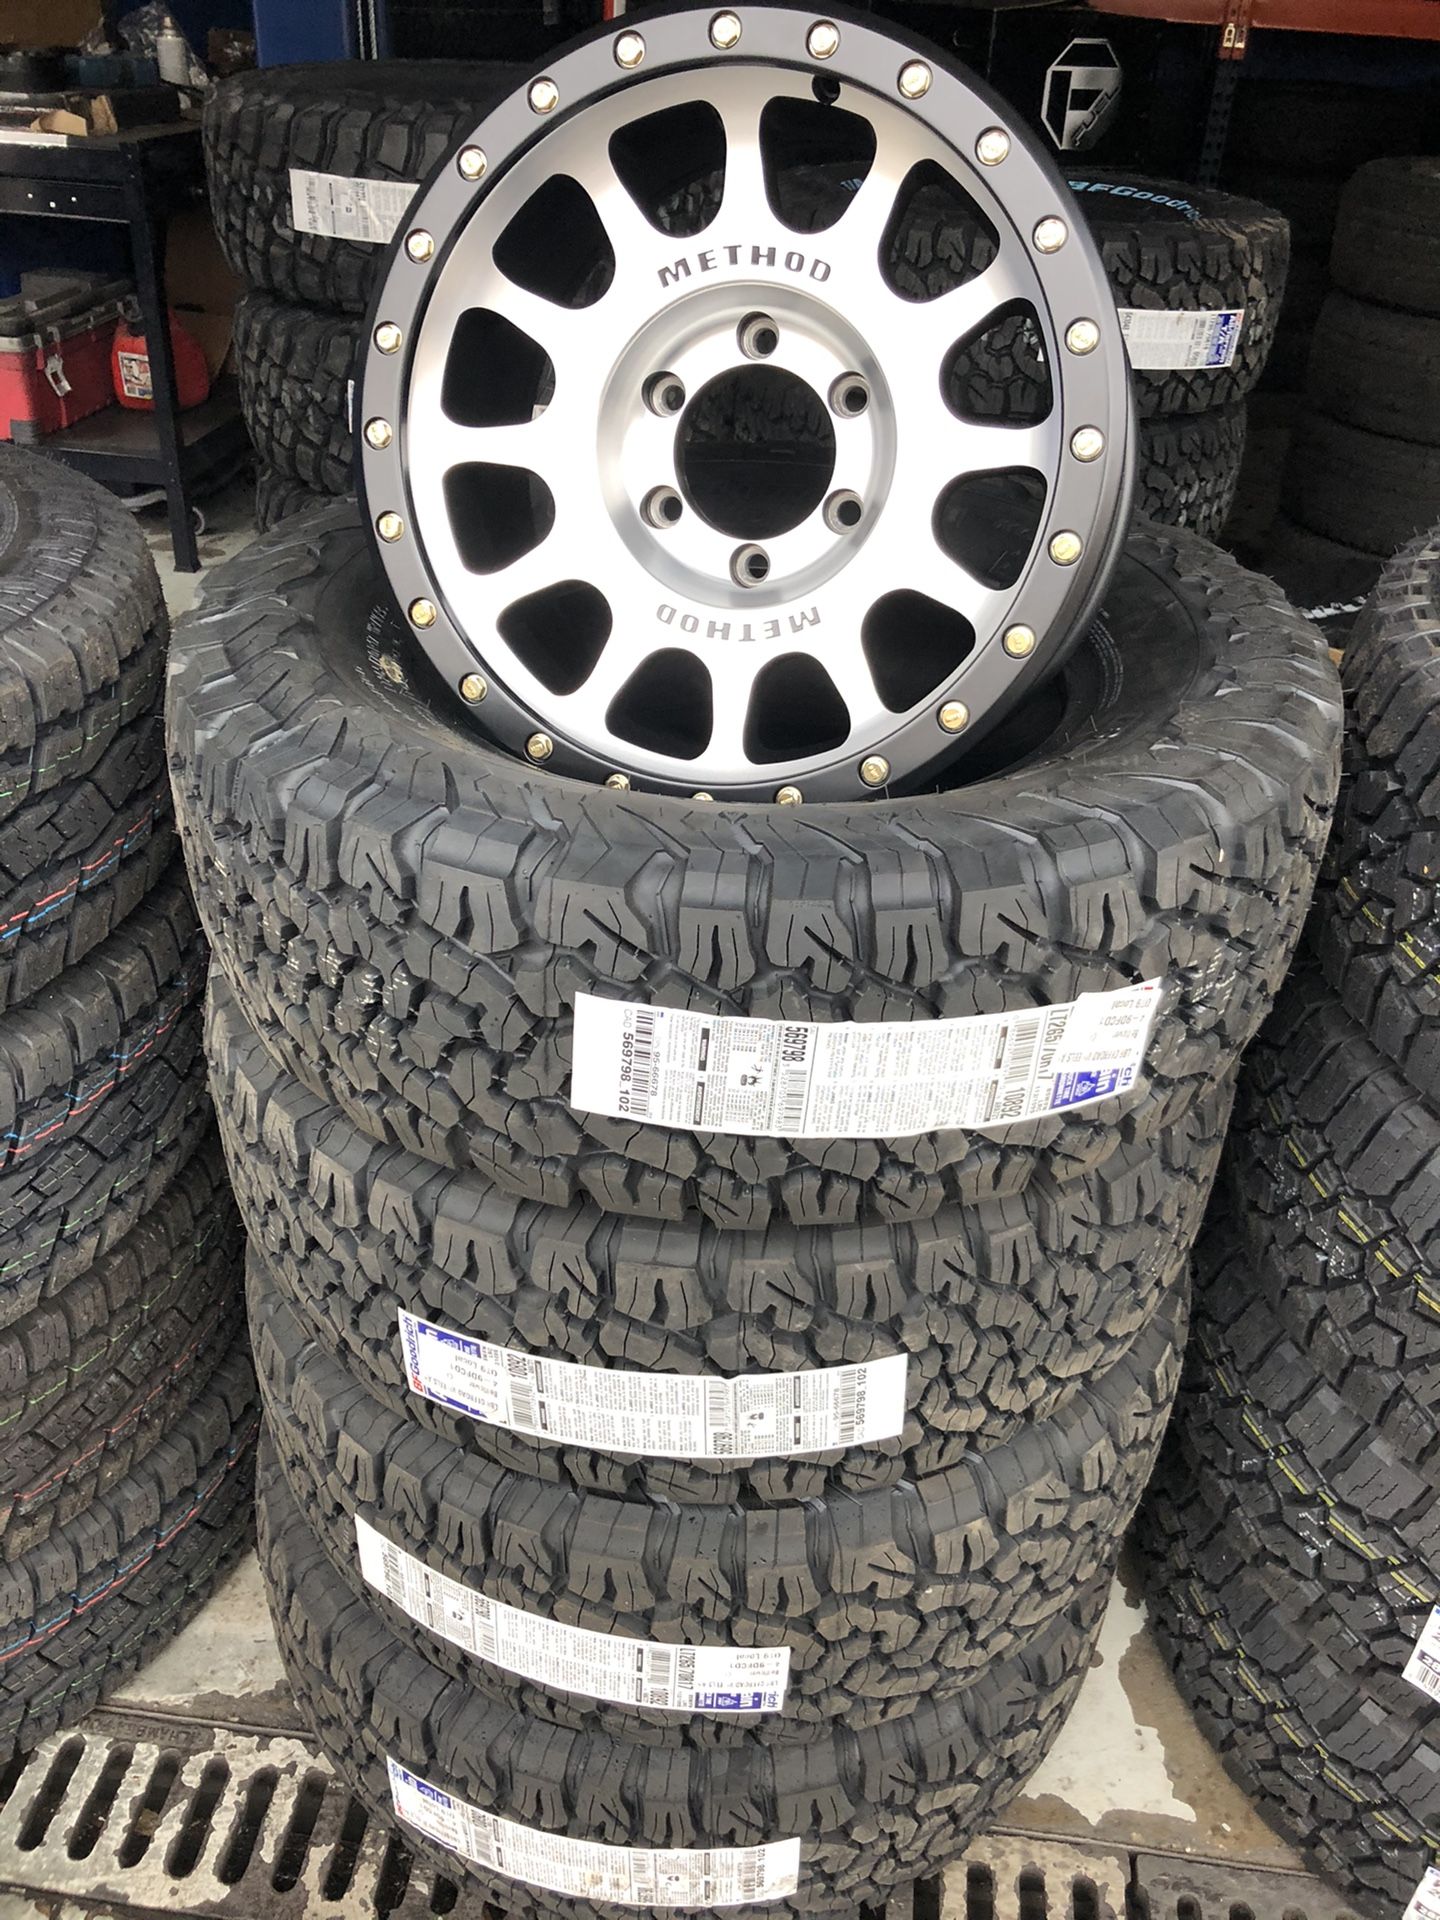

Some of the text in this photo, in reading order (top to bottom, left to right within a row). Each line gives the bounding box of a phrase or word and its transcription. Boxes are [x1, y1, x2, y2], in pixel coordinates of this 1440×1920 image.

[1071, 86, 1121, 147] FUEL
[657, 245, 831, 288] METHOD
[656, 604, 821, 642] METHOD
[781, 1025, 809, 1062] 569798
[650, 1051, 661, 1096] 95-66678
[999, 1087, 1026, 1119] 10892
[402, 1314, 424, 1394] BFGoodrich
[506, 1353, 528, 1379] 10892
[713, 1432, 733, 1455] 569798
